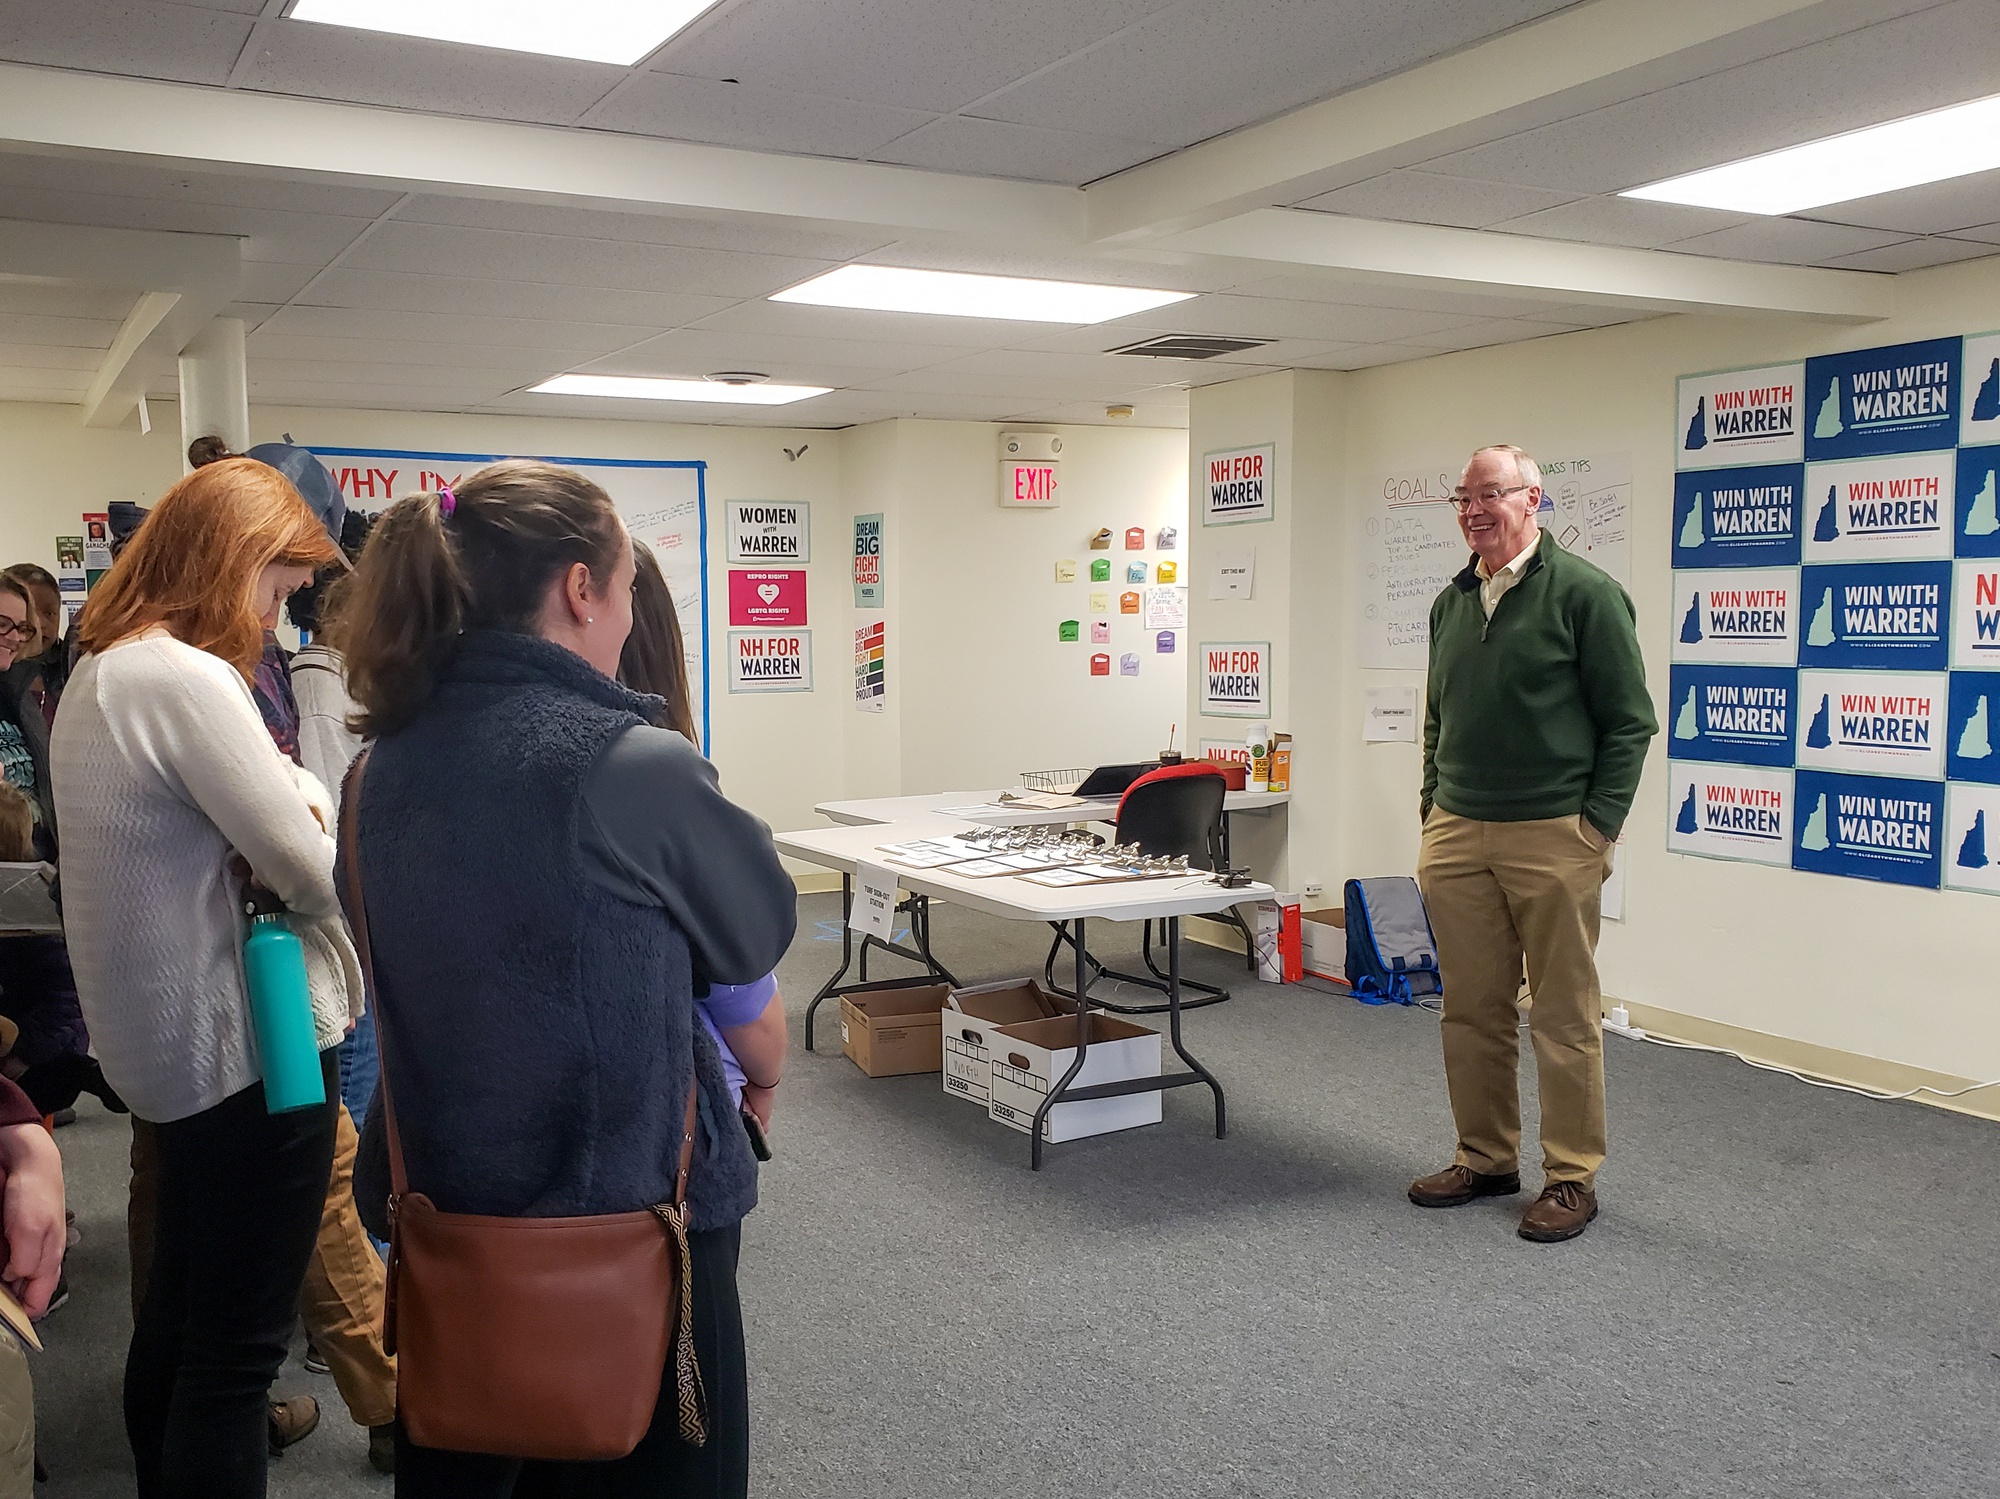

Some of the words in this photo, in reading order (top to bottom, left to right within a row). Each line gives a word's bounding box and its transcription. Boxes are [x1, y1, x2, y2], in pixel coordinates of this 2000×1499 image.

[1852, 369, 1891, 394] WIN
[1896, 361, 1949, 388] WITH
[1714, 391, 1744, 411] WIN
[1749, 385, 1793, 407] WITH
[1852, 385, 1947, 422] WARREN
[1714, 406, 1792, 436] WARREN
[1211, 459, 1230, 483] NH
[1234, 455, 1263, 480] FOR
[1571, 460, 1591, 474] TIPS
[1016, 468, 1052, 500] EXIT
[1211, 480, 1263, 506] WARREN
[1384, 473, 1451, 501] GOALS
[1849, 481, 1884, 501] WIN
[1889, 477, 1939, 499] WITH
[1712, 489, 1745, 509] WIN
[1748, 485, 1793, 507] WITH
[739, 507, 796, 524] WOMEN
[1712, 507, 1792, 535] WARREN
[1848, 499, 1938, 528] WARREN
[763, 526, 777, 534] WITH
[856, 522, 879, 537] DREAM
[1385, 518, 1425, 534] DATA
[740, 535, 797, 553] WARREN
[855, 536, 879, 556] BIG
[1384, 535, 1417, 546] WARREN
[1414, 540, 1456, 552] CANDIDATES
[855, 556, 879, 573] FIGHT
[855, 573, 879, 584] HARD
[1976, 573, 1998, 606] N
[1710, 591, 1741, 608] WIN
[1745, 590, 1786, 608] WITH
[1845, 586, 1883, 606] WIN
[1887, 584, 1939, 605] WITH
[1710, 610, 1786, 633] WARREN
[1844, 607, 1938, 634] WARREN
[855, 625, 873, 641] DREAM
[740, 639, 763, 657] NH
[768, 638, 799, 656] FOR
[855, 641, 864, 654] BIG
[855, 651, 869, 665] FIGHT
[740, 658, 800, 676] WARREN
[855, 664, 869, 678] HARD
[1209, 651, 1228, 673] NH
[1232, 651, 1259, 674] FOR
[856, 677, 866, 690] LIVE
[856, 687, 873, 702] PROUD
[1209, 675, 1259, 697] WARREN
[1706, 686, 1739, 705] WIN
[1742, 687, 1787, 707] WITH
[1841, 694, 1877, 714] WIN
[1881, 696, 1931, 716] WITH
[1706, 706, 1786, 734] WARREN
[1841, 715, 1929, 744] WARREN
[1231, 750, 1247, 763] FO
[1706, 784, 1736, 804] WIN
[1740, 787, 1781, 809] WITH
[1706, 803, 1781, 834] WARREN
[1838, 794, 1876, 817] WIN
[1880, 798, 1931, 823] WITH
[1838, 816, 1930, 852] WARREN
[948, 1077, 969, 1091] 33250
[994, 1103, 1015, 1119] 33250
